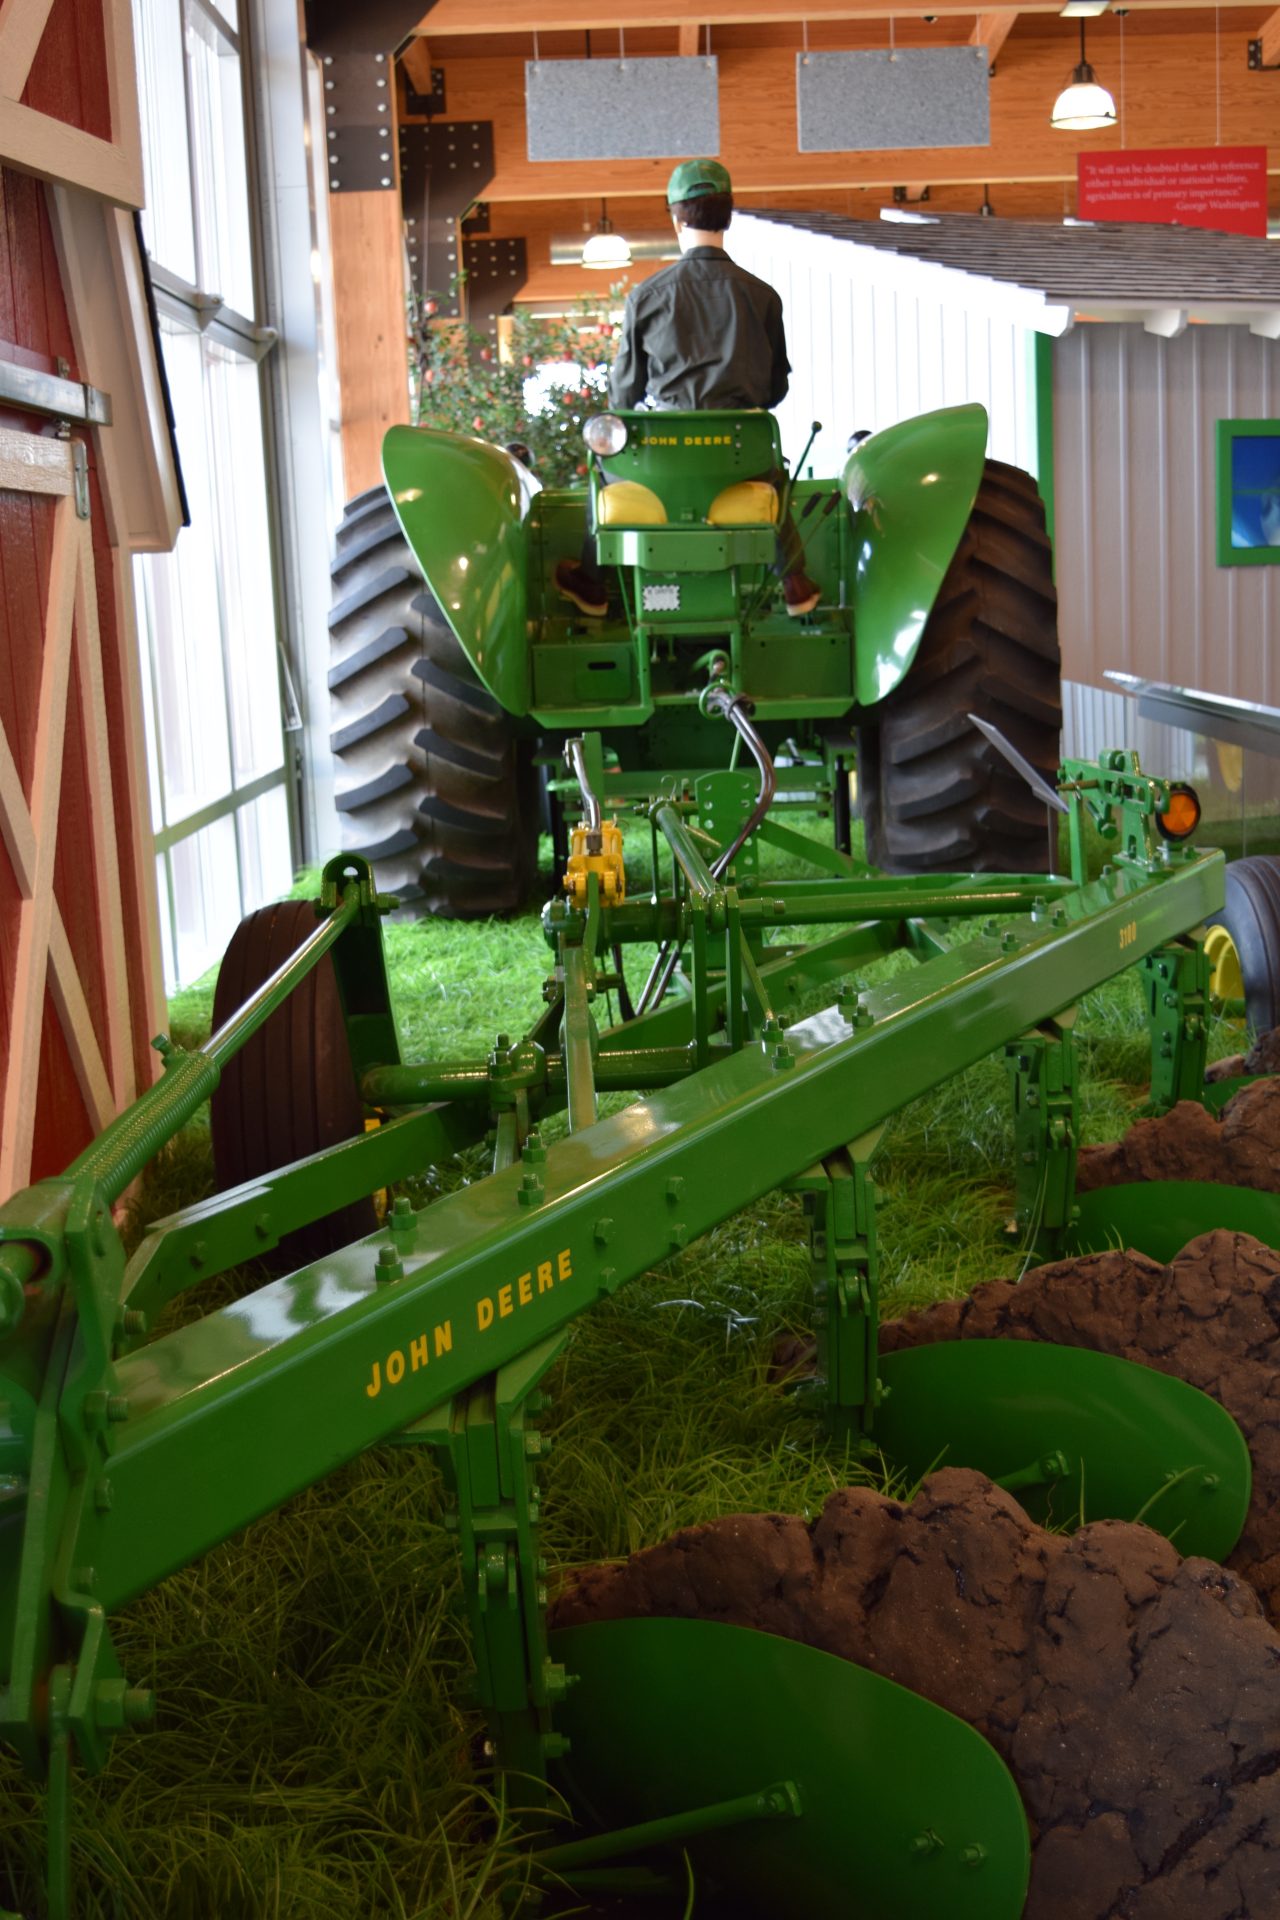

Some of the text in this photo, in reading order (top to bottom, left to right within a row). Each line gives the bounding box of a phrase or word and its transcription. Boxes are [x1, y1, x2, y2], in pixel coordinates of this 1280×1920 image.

[1098, 165, 1115, 174] will
[1115, 165, 1130, 174] not
[1131, 164, 1143, 174] be
[1143, 163, 1180, 173] doubted
[1181, 163, 1198, 172] that
[1200, 160, 1219, 171] with
[1220, 161, 1259, 170] reference
[1085, 178, 1110, 188] either
[1111, 178, 1121, 187] to
[1122, 176, 1166, 187] individual
[1179, 175, 1214, 185] national
[1086, 191, 1132, 203] agriculture
[1153, 190, 1188, 202] primary
[1208, 200, 1260, 212] Washington
[641, 436, 732, 446] JOHN DEERE
[366, 1248, 573, 1398] JOHN DEERE
